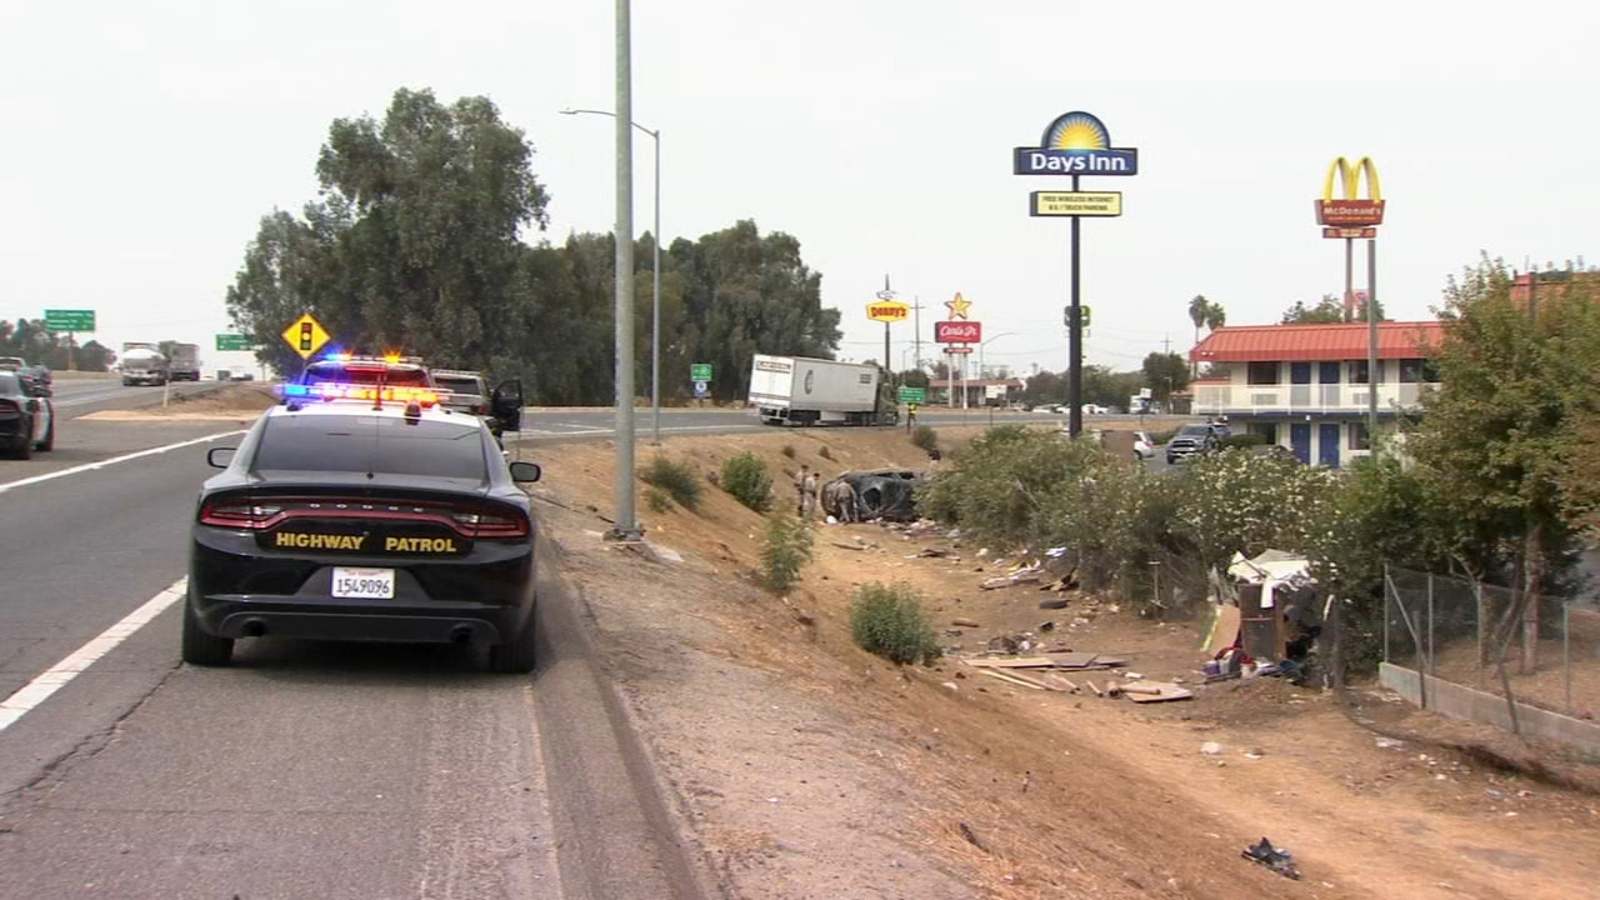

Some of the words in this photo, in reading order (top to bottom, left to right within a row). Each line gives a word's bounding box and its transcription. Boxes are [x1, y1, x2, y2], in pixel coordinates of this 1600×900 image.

[1030, 153, 1086, 173] Days
[1089, 153, 1126, 171] Inn
[871, 307, 907, 318] Denny's
[276, 532, 364, 550] HIGHWAY
[385, 537, 457, 553] PATROL
[336, 578, 390, 594] 1549096
